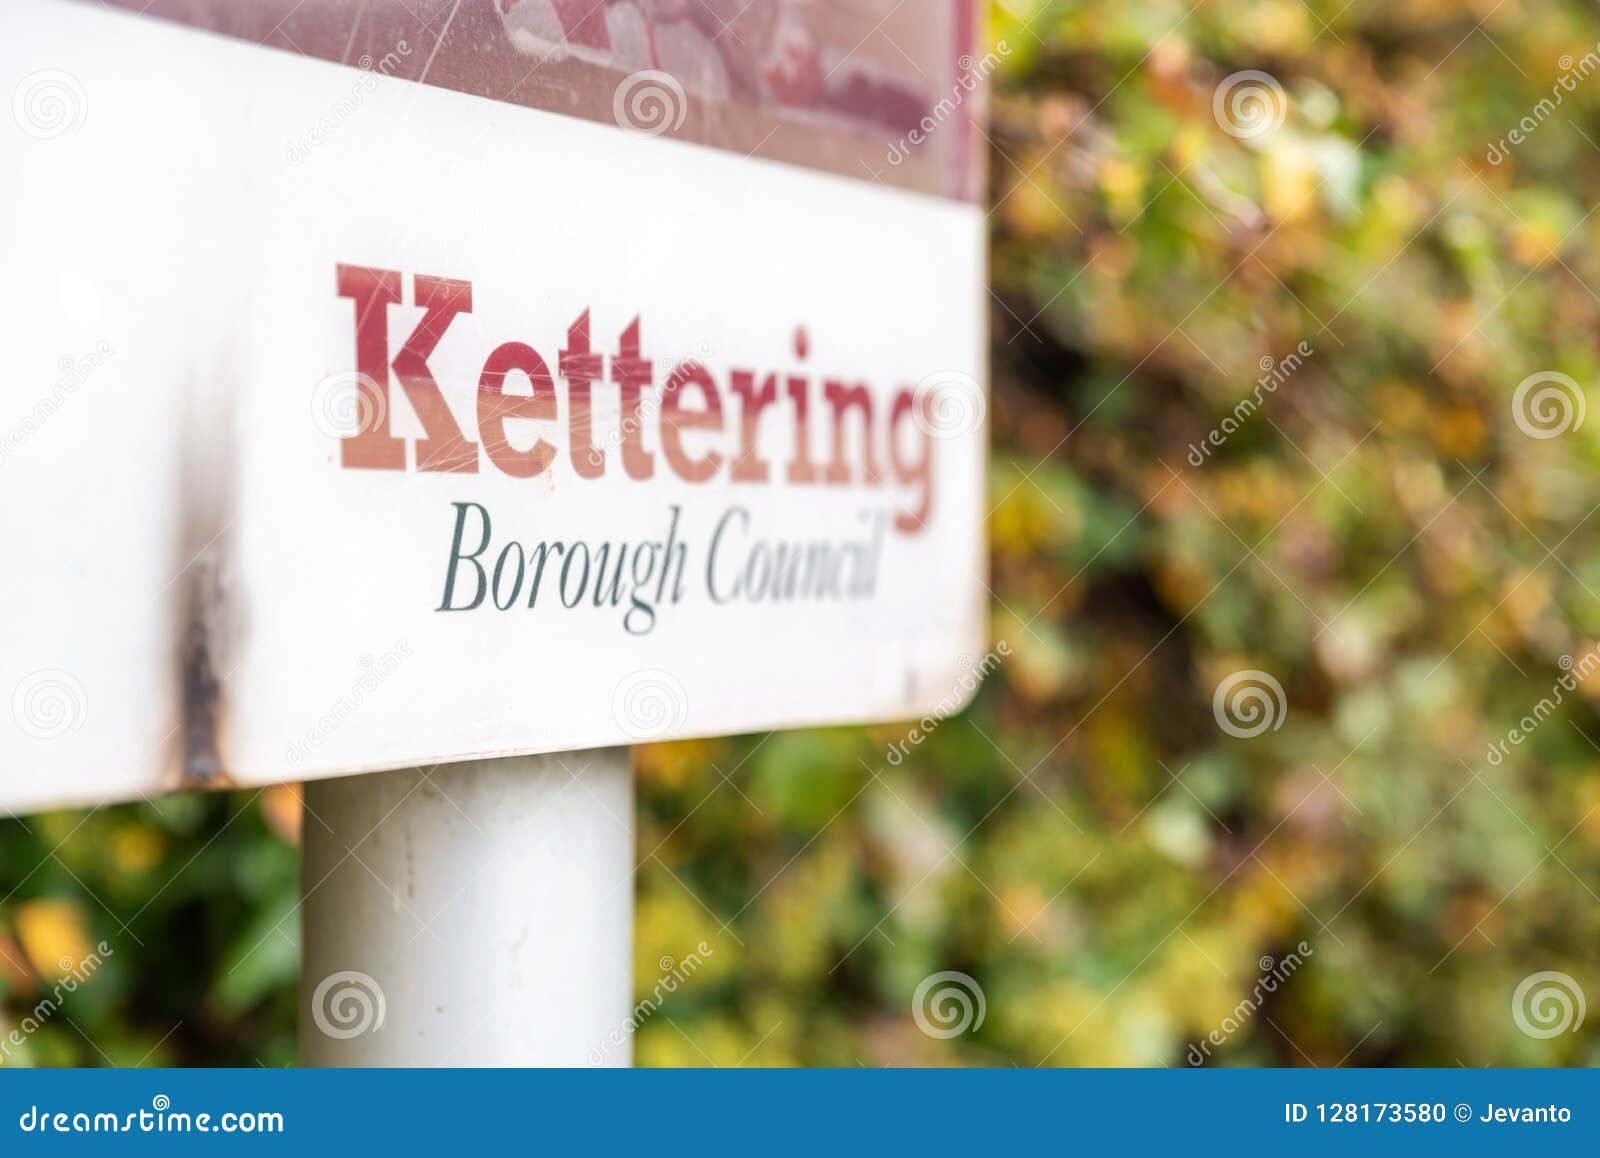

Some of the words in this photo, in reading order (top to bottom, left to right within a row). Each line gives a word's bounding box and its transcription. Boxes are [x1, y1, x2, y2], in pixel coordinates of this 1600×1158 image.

[335, 262, 935, 535] Kettering
[434, 501, 688, 635] Borough
[705, 505, 885, 604] Council
